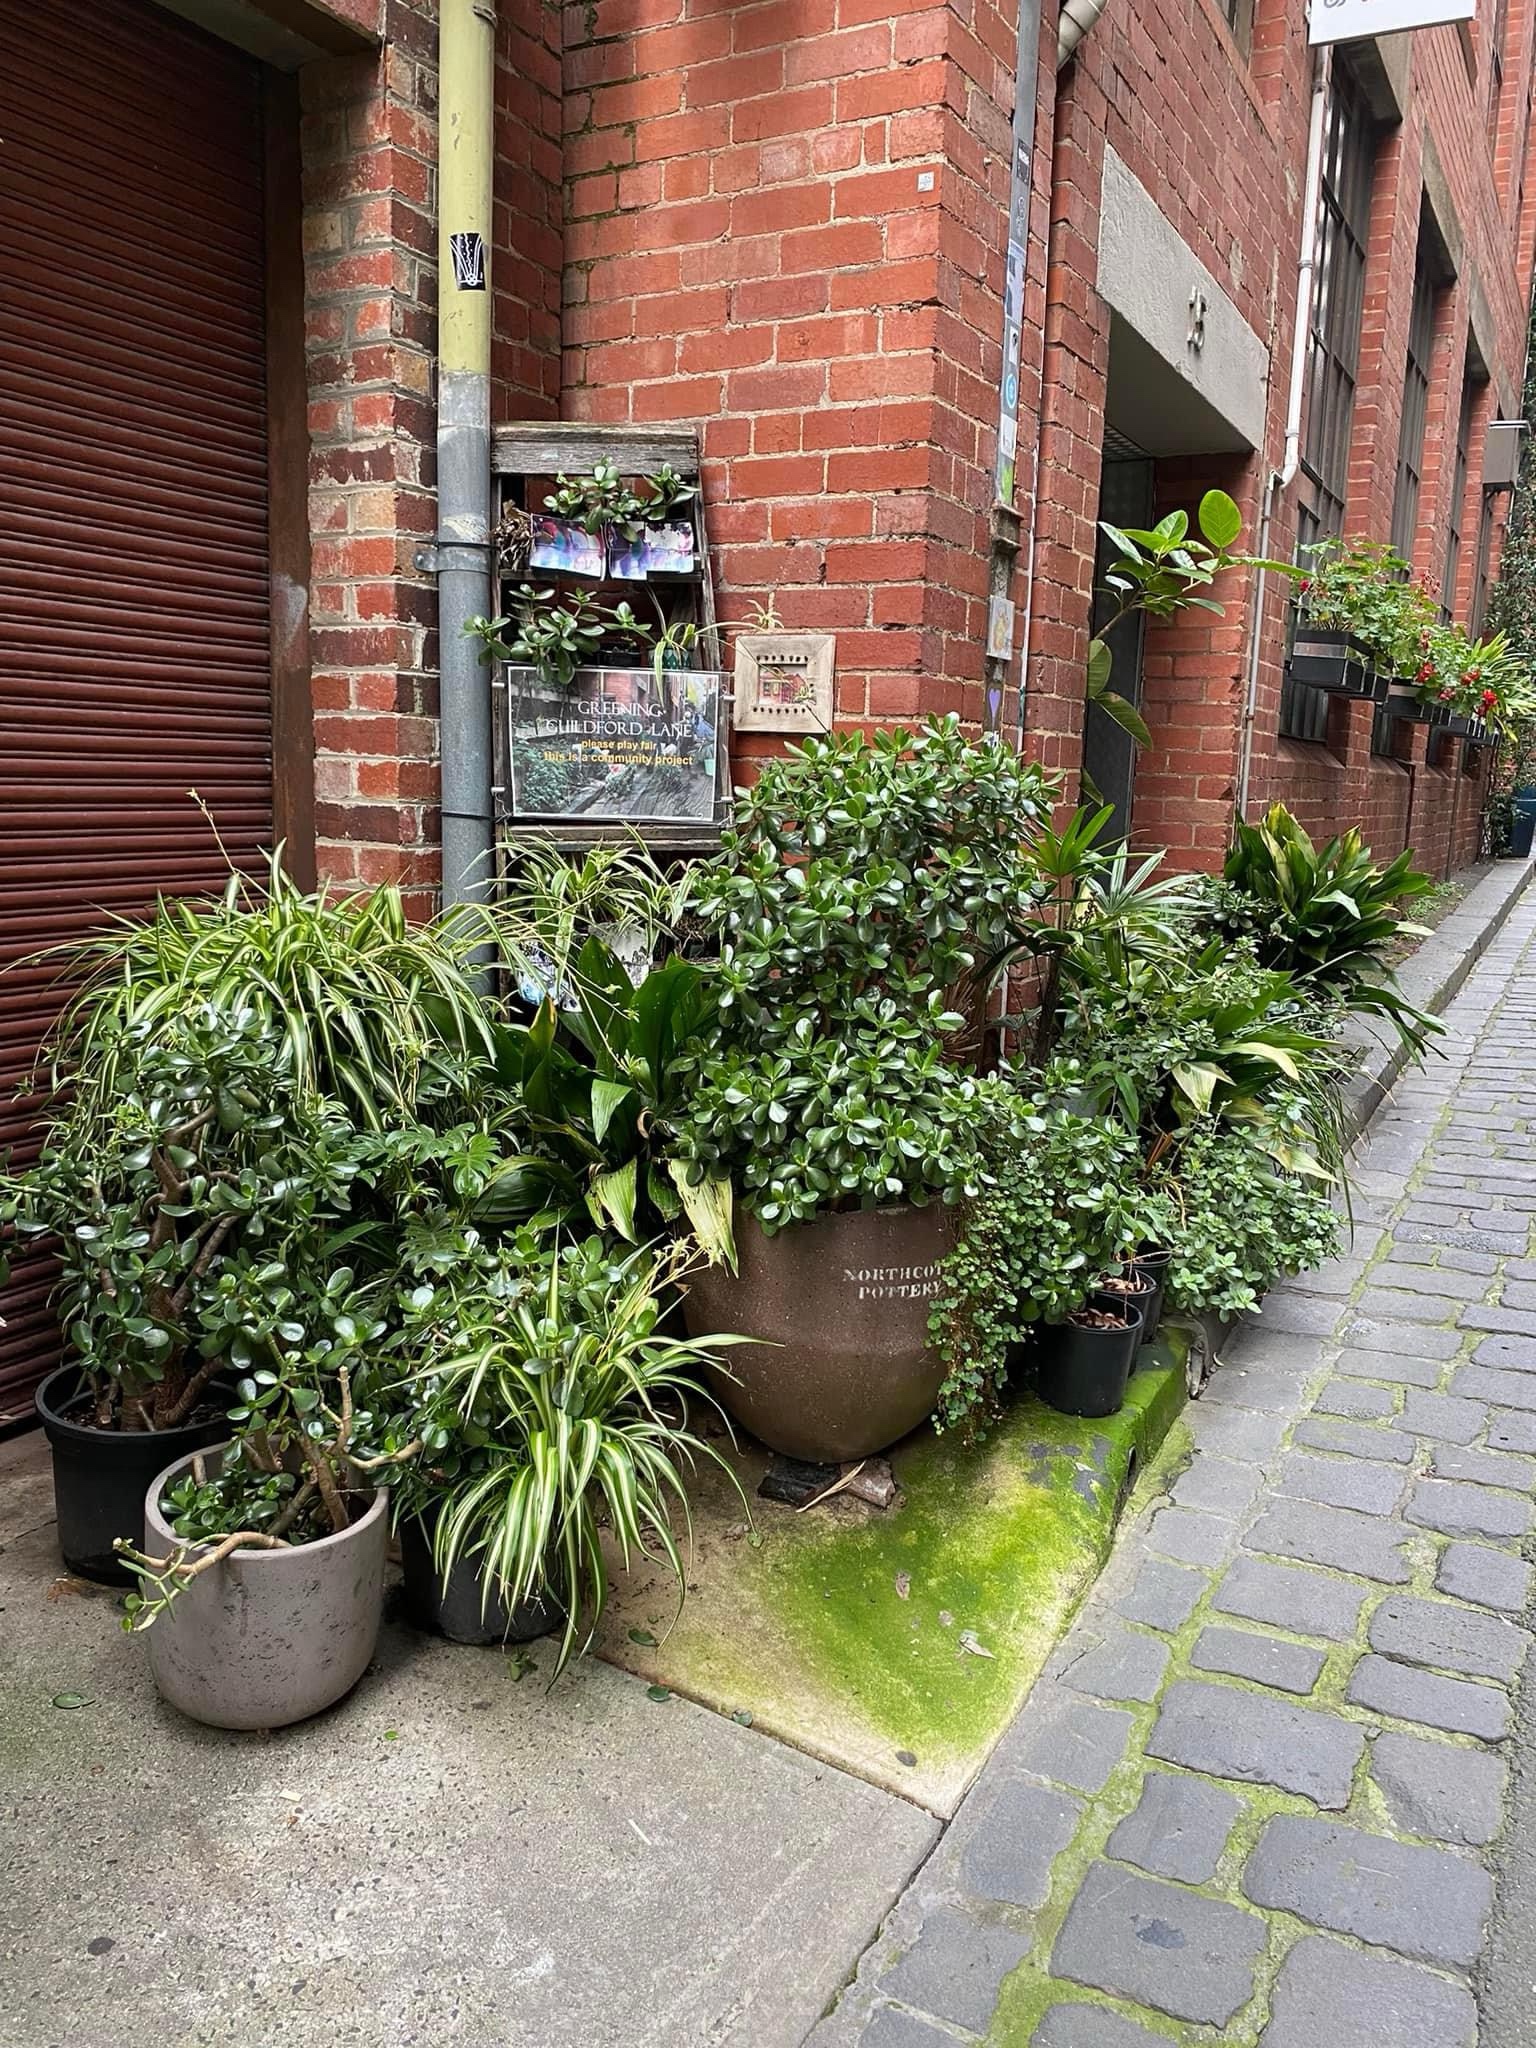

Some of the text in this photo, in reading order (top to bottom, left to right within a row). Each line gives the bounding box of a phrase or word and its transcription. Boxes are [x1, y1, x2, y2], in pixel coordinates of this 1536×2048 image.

[577, 701, 663, 718] GREENING
[546, 719, 692, 738] GUILDFORD LANE
[581, 739, 657, 751] please play fair
[581, 754, 588, 762] a
[591, 753, 652, 767] community
[654, 755, 693, 768] project
[842, 1265, 941, 1281] NORTHCOT
[858, 1281, 942, 1299] POTTERY
